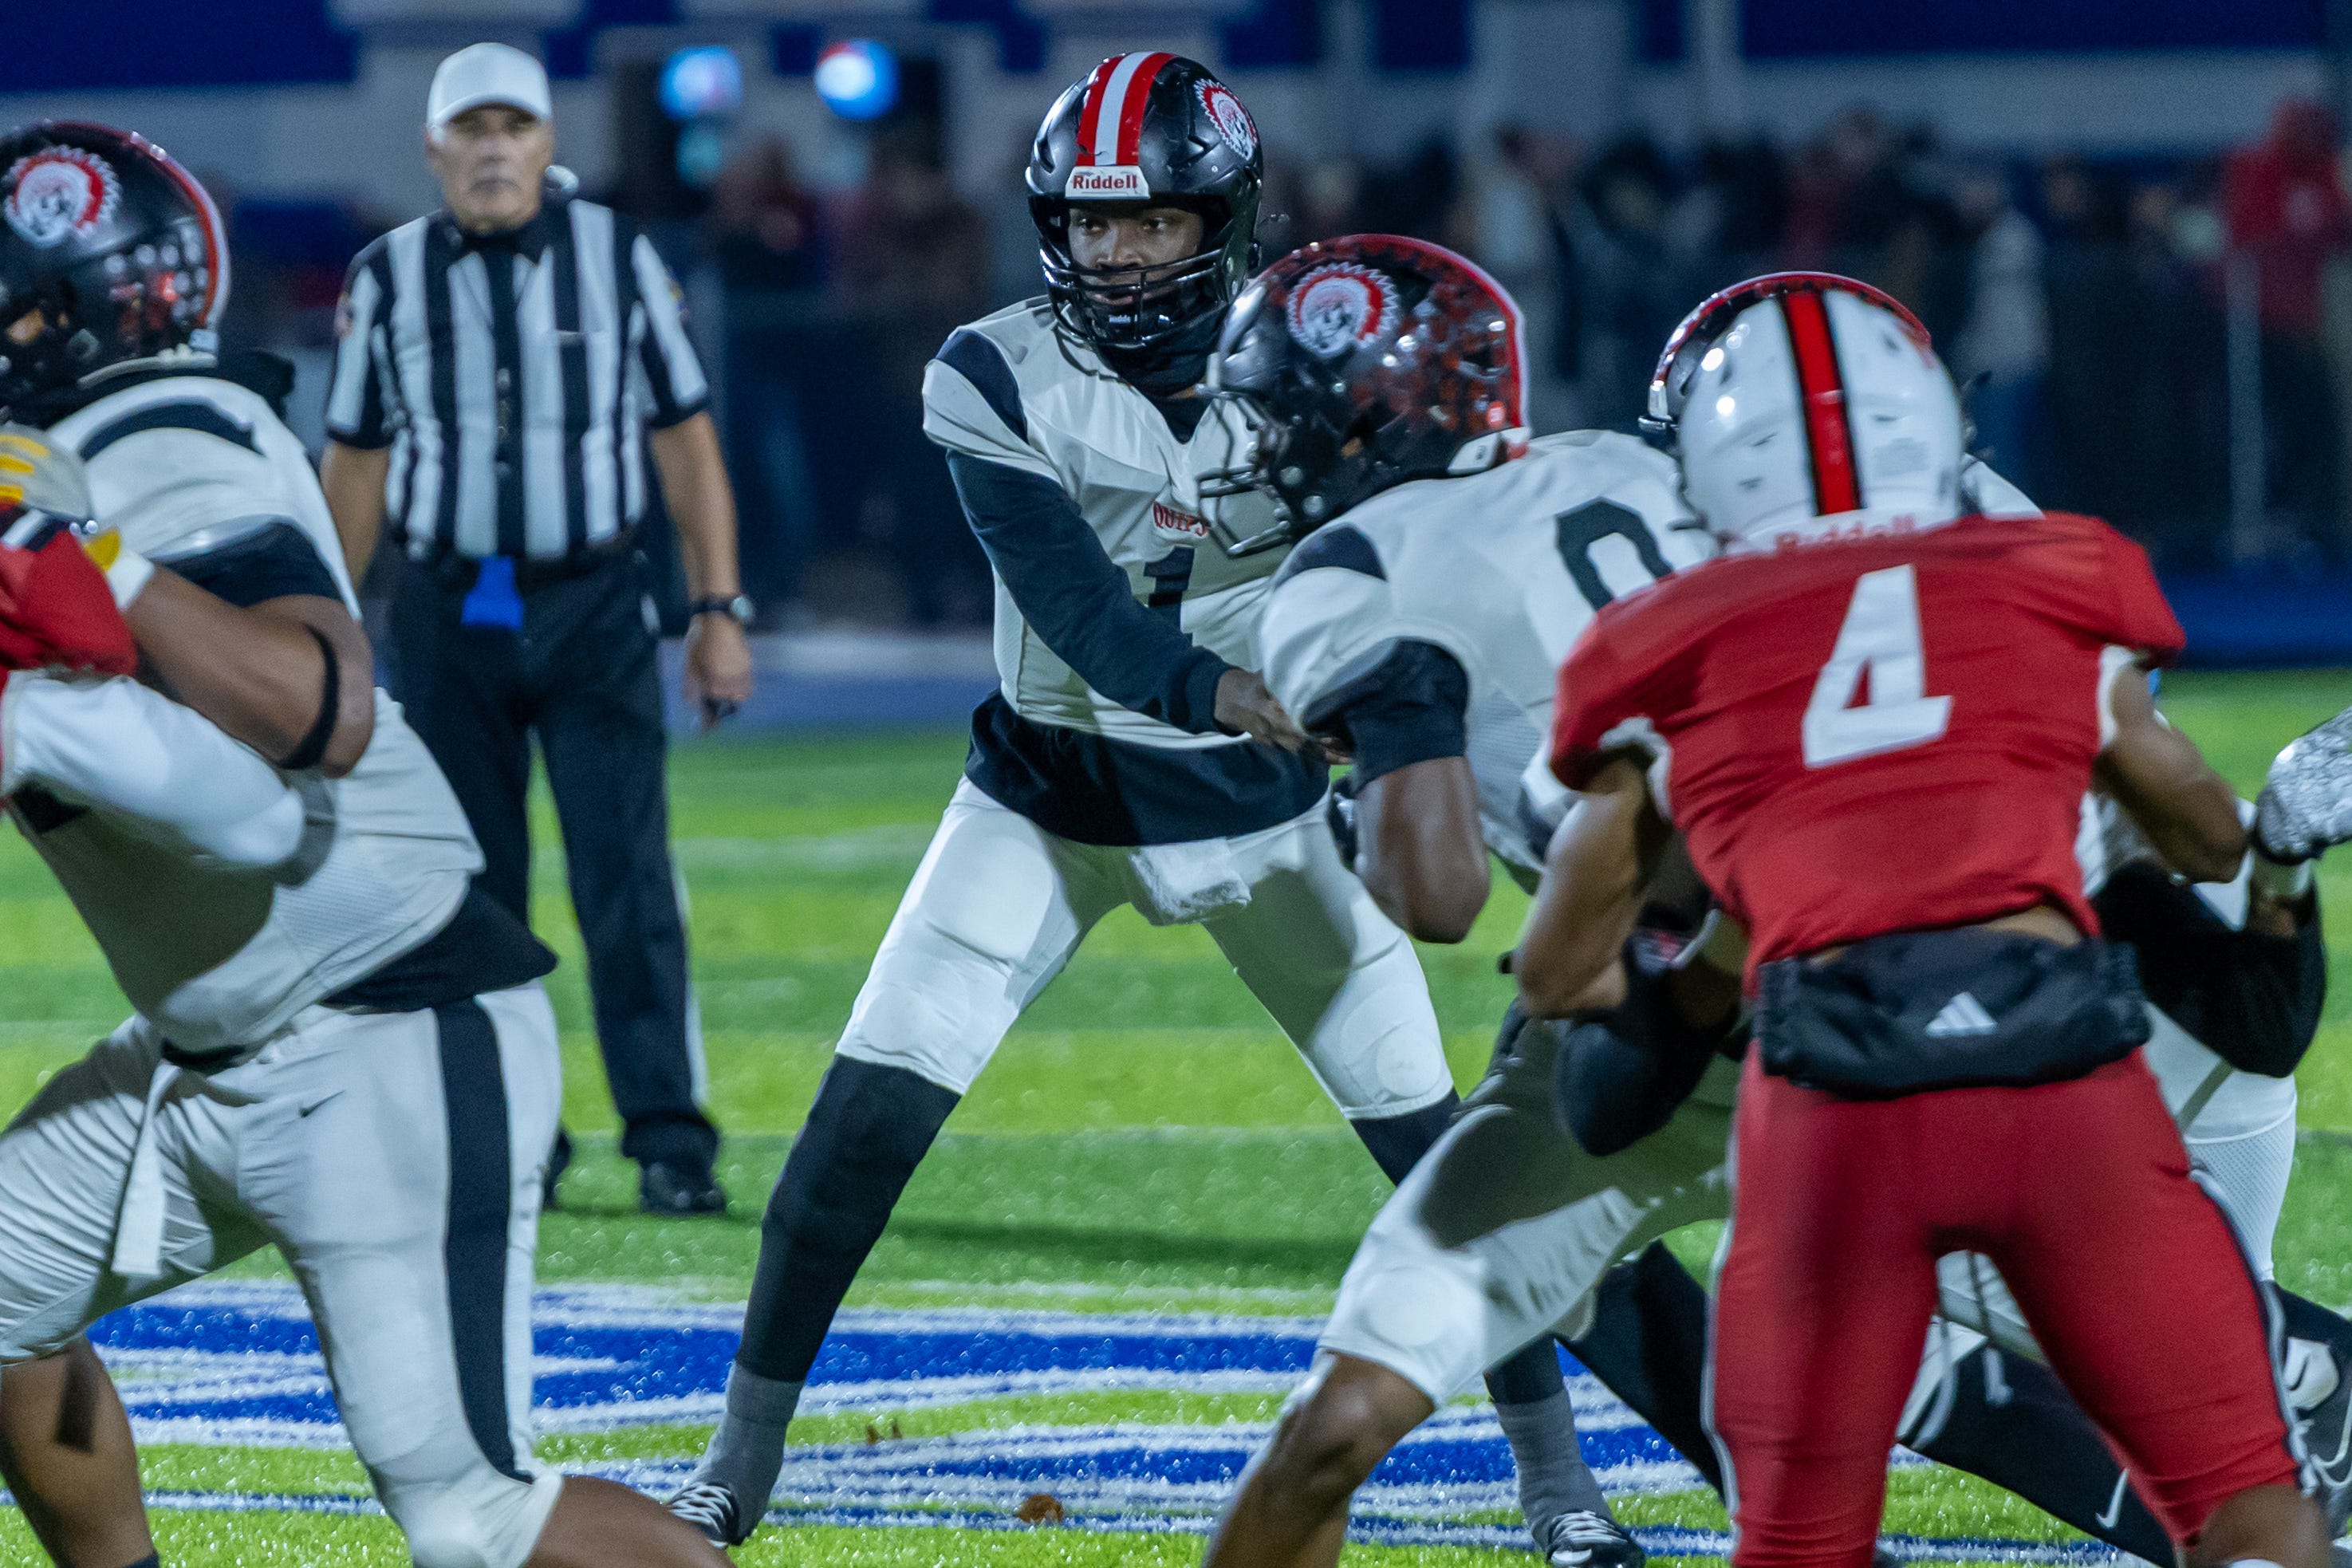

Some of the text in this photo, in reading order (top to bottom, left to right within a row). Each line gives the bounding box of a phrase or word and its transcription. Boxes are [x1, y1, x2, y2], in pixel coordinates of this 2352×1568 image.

[1073, 175, 1137, 189] Riddell
[1143, 546, 1195, 616] 1
[1801, 562, 1953, 770] 4
